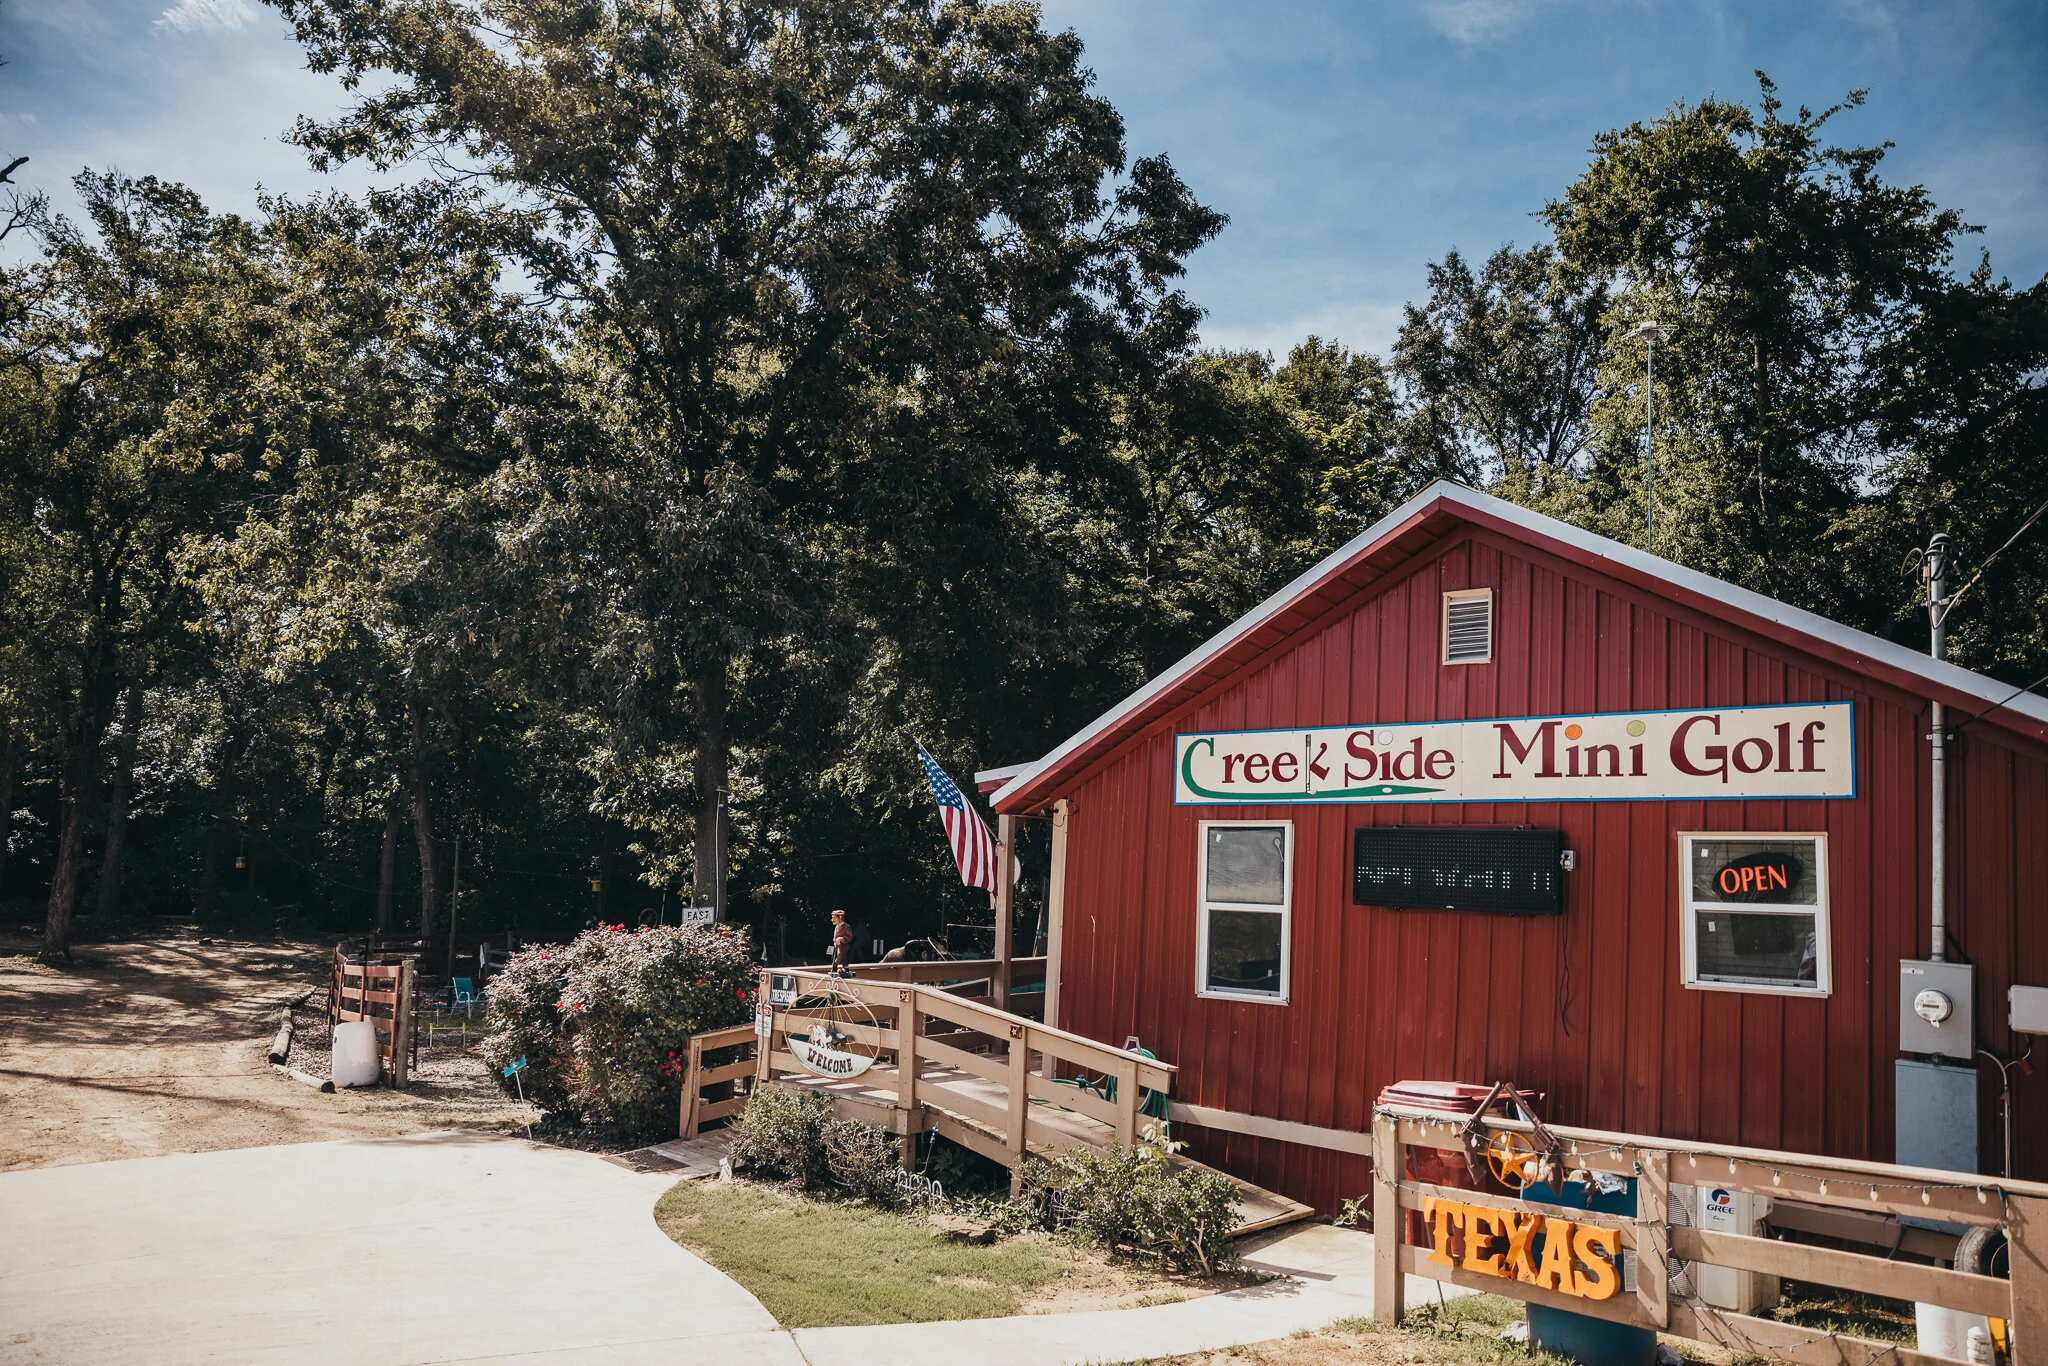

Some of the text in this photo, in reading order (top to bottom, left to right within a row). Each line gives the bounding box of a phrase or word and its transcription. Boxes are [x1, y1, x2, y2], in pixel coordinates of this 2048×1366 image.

[1181, 714, 1826, 799] Creek Side Mini Golf
[1719, 863, 1788, 894] OPEN
[687, 911, 709, 920] EAST
[772, 989, 797, 1003] TRESPASS
[807, 1047, 853, 1073] WELCOME
[1706, 1204, 1735, 1214] GREE
[1423, 1196, 1621, 1300] TEXAS
